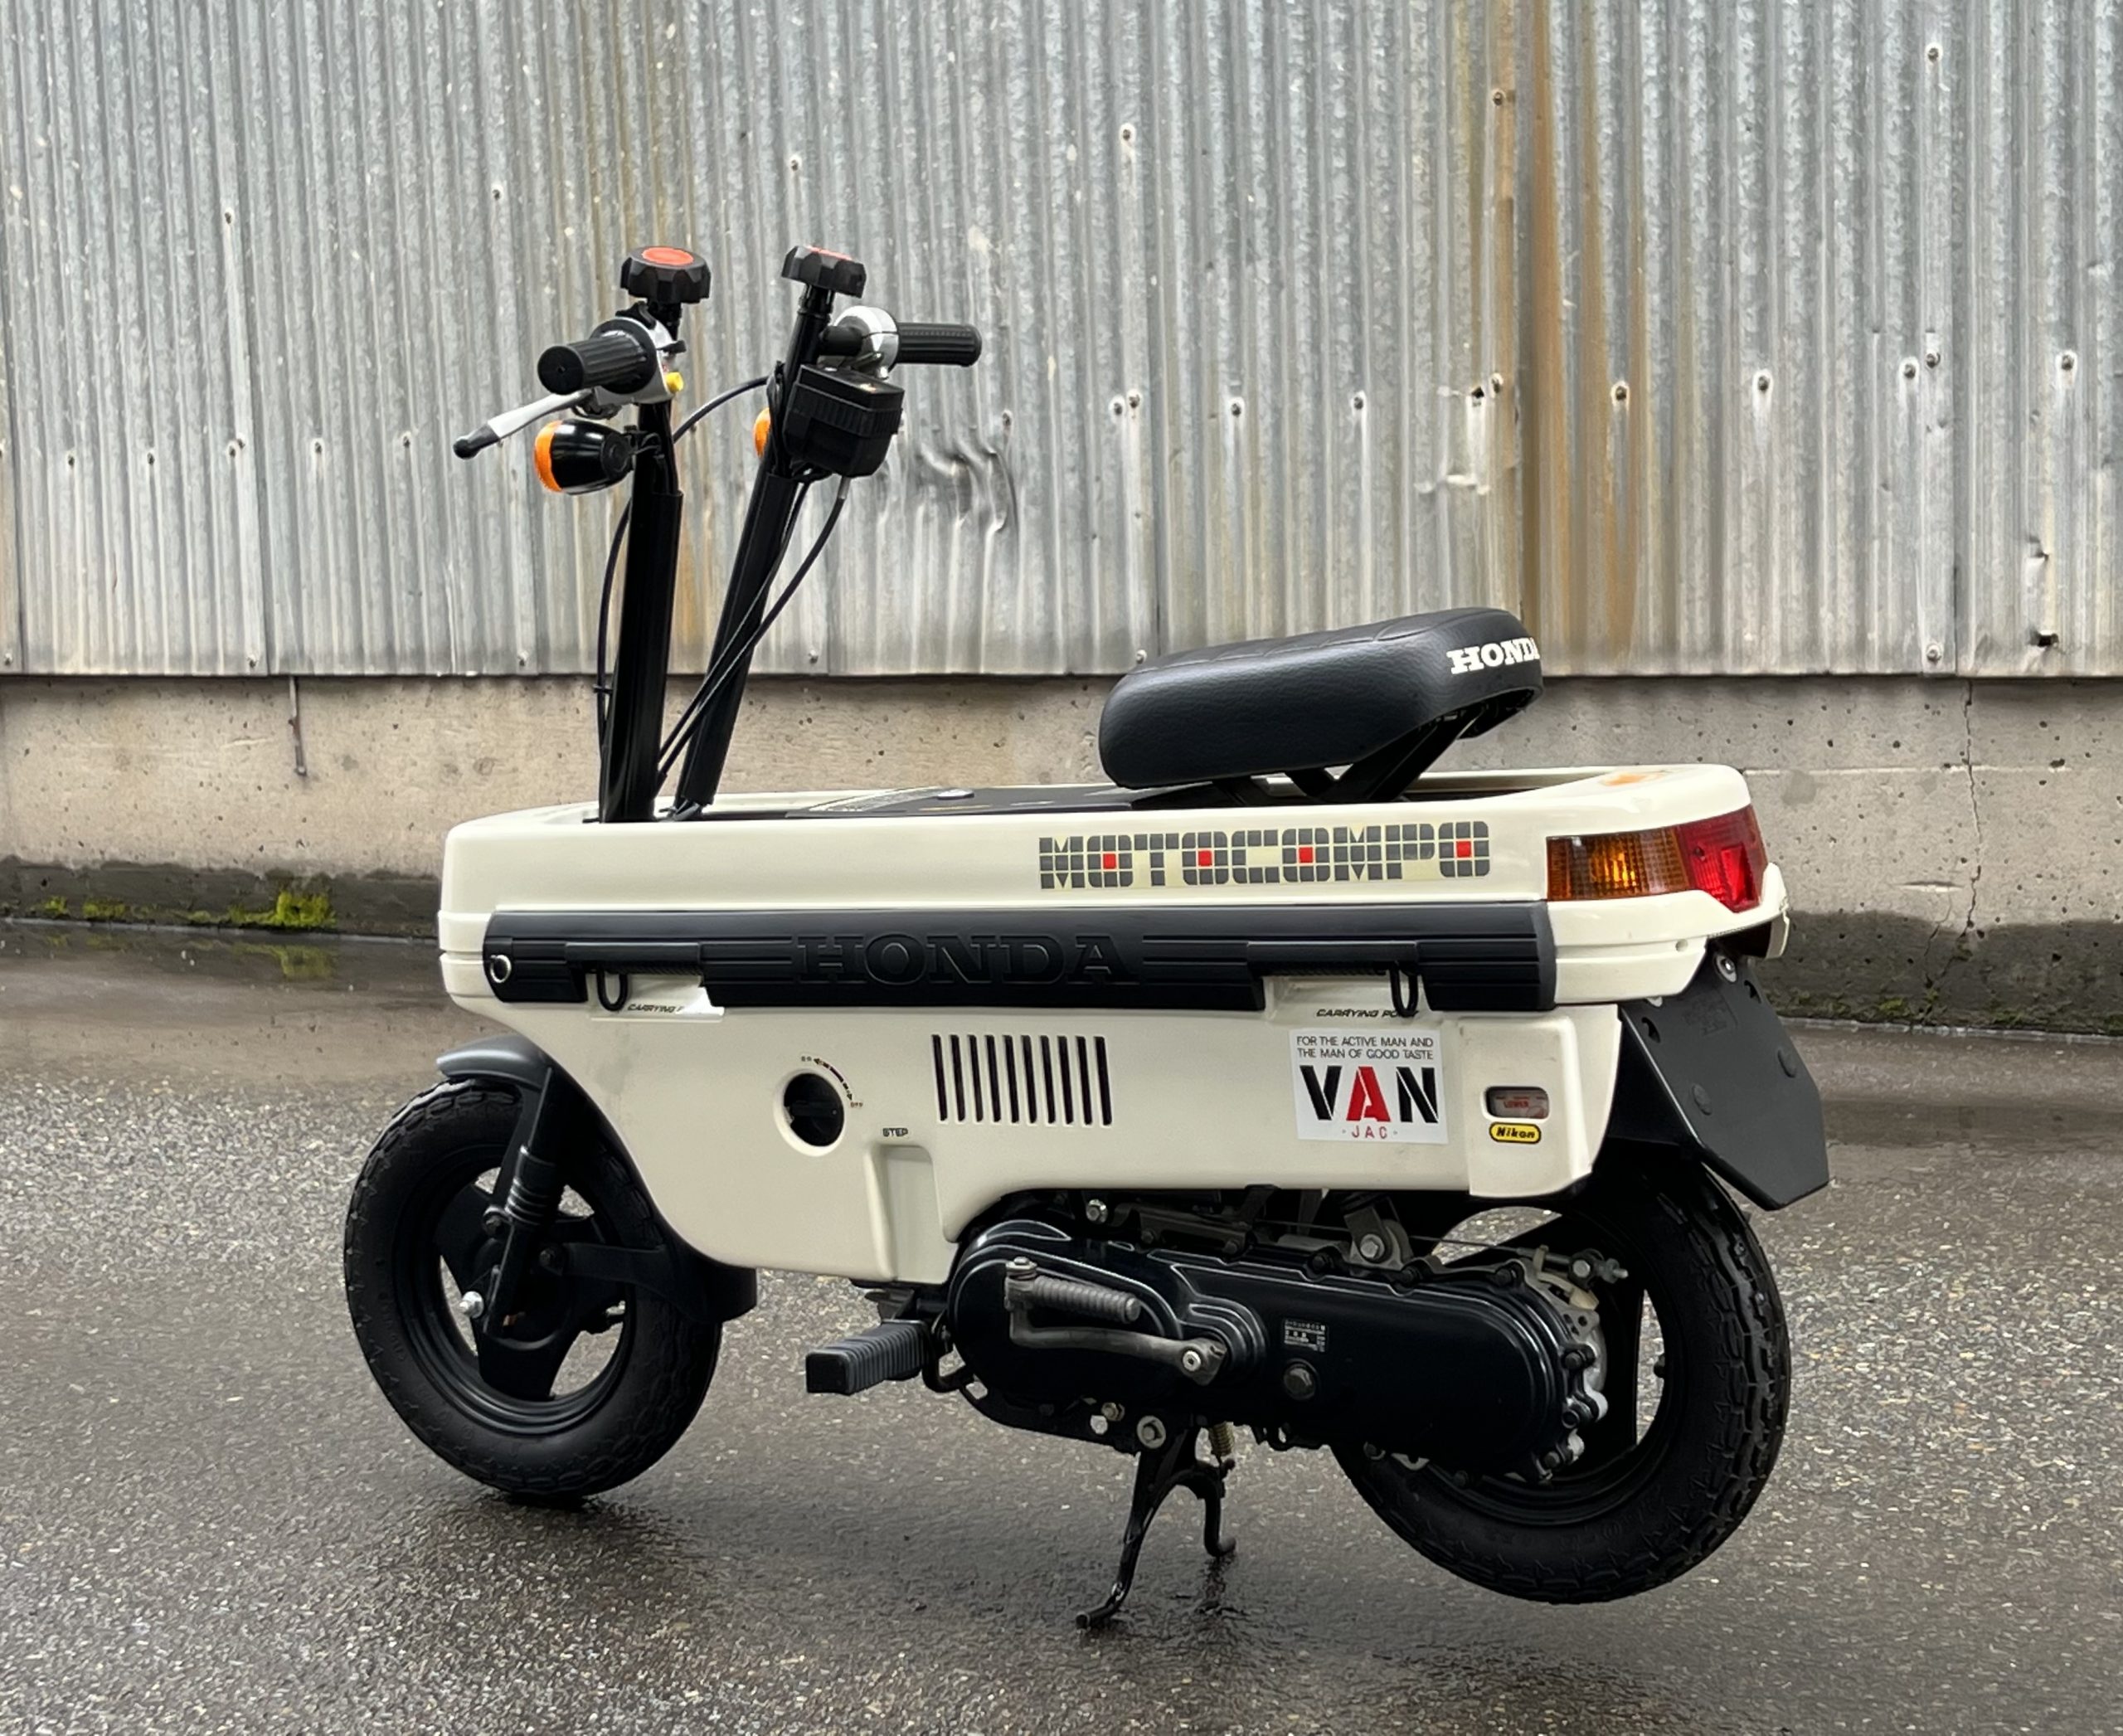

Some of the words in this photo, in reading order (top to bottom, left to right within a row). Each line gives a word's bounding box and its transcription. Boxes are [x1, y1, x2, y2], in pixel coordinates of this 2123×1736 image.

[1039, 821, 1490, 890] MOTOCOMPO
[797, 933, 1140, 985] HONDA
[1316, 1009, 1379, 1018] CARRYING
[1297, 1036, 1317, 1046] FOR
[1319, 1036, 1338, 1047] THE
[1341, 1036, 1377, 1047] ACTIVE
[1381, 1037, 1406, 1047] MAN
[1410, 1038, 1434, 1048] AND
[1297, 1048, 1316, 1058] THE
[1320, 1048, 1345, 1058] MAN
[1348, 1048, 1363, 1059] OF
[1366, 1048, 1400, 1059] GOOD
[1402, 1049, 1434, 1060] TASTE
[1300, 1065, 1439, 1123] VAN
[882, 1127, 909, 1137] STEP
[1495, 1126, 1536, 1139] Nikon
